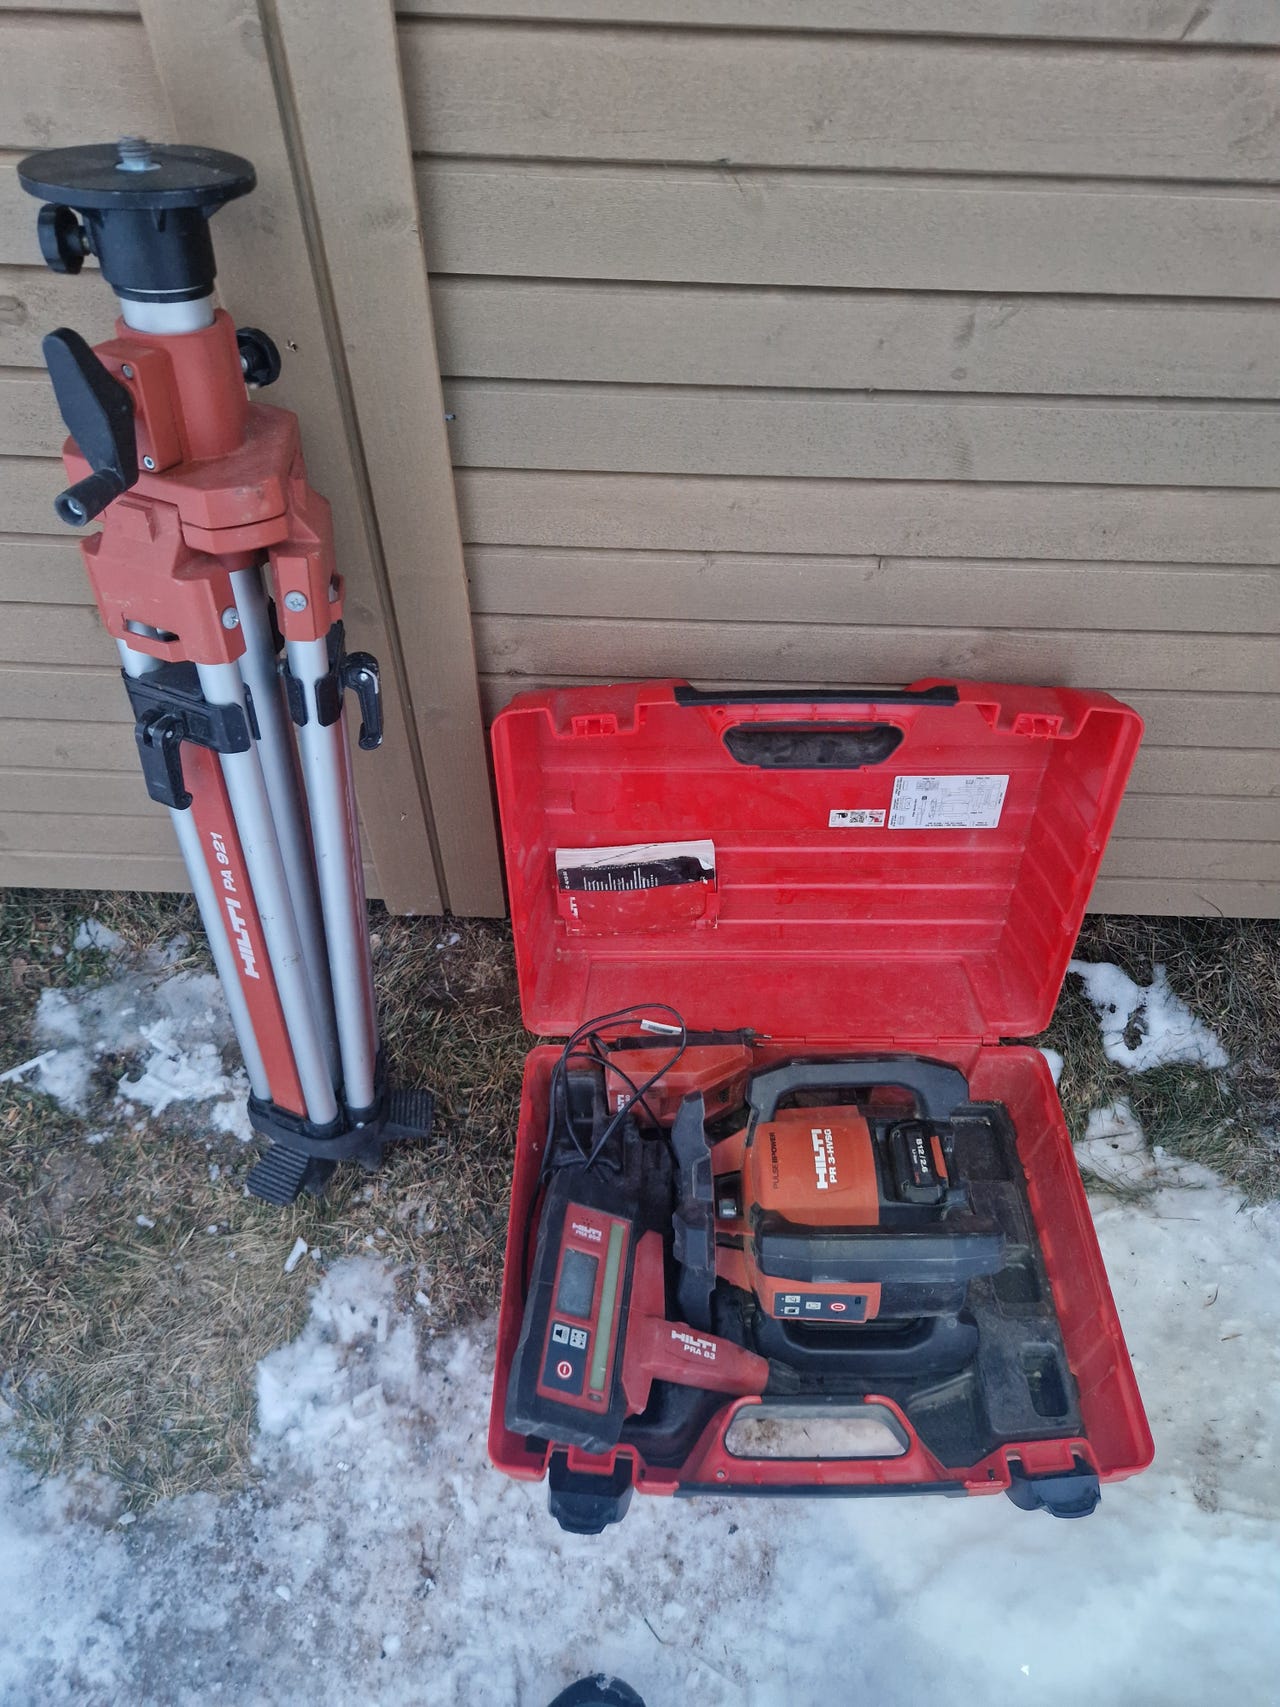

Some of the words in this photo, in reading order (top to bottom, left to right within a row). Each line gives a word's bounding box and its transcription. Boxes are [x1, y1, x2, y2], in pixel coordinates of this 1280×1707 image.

[210, 831, 230, 865] 921
[220, 870, 237, 892] PA
[225, 896, 260, 979] HILTI
[811, 1128, 829, 1189] HILTI
[828, 1167, 837, 1183] PR
[572, 1221, 602, 1237] HILTI
[671, 1329, 717, 1352] HILTI
[683, 1343, 702, 1356] PRA
